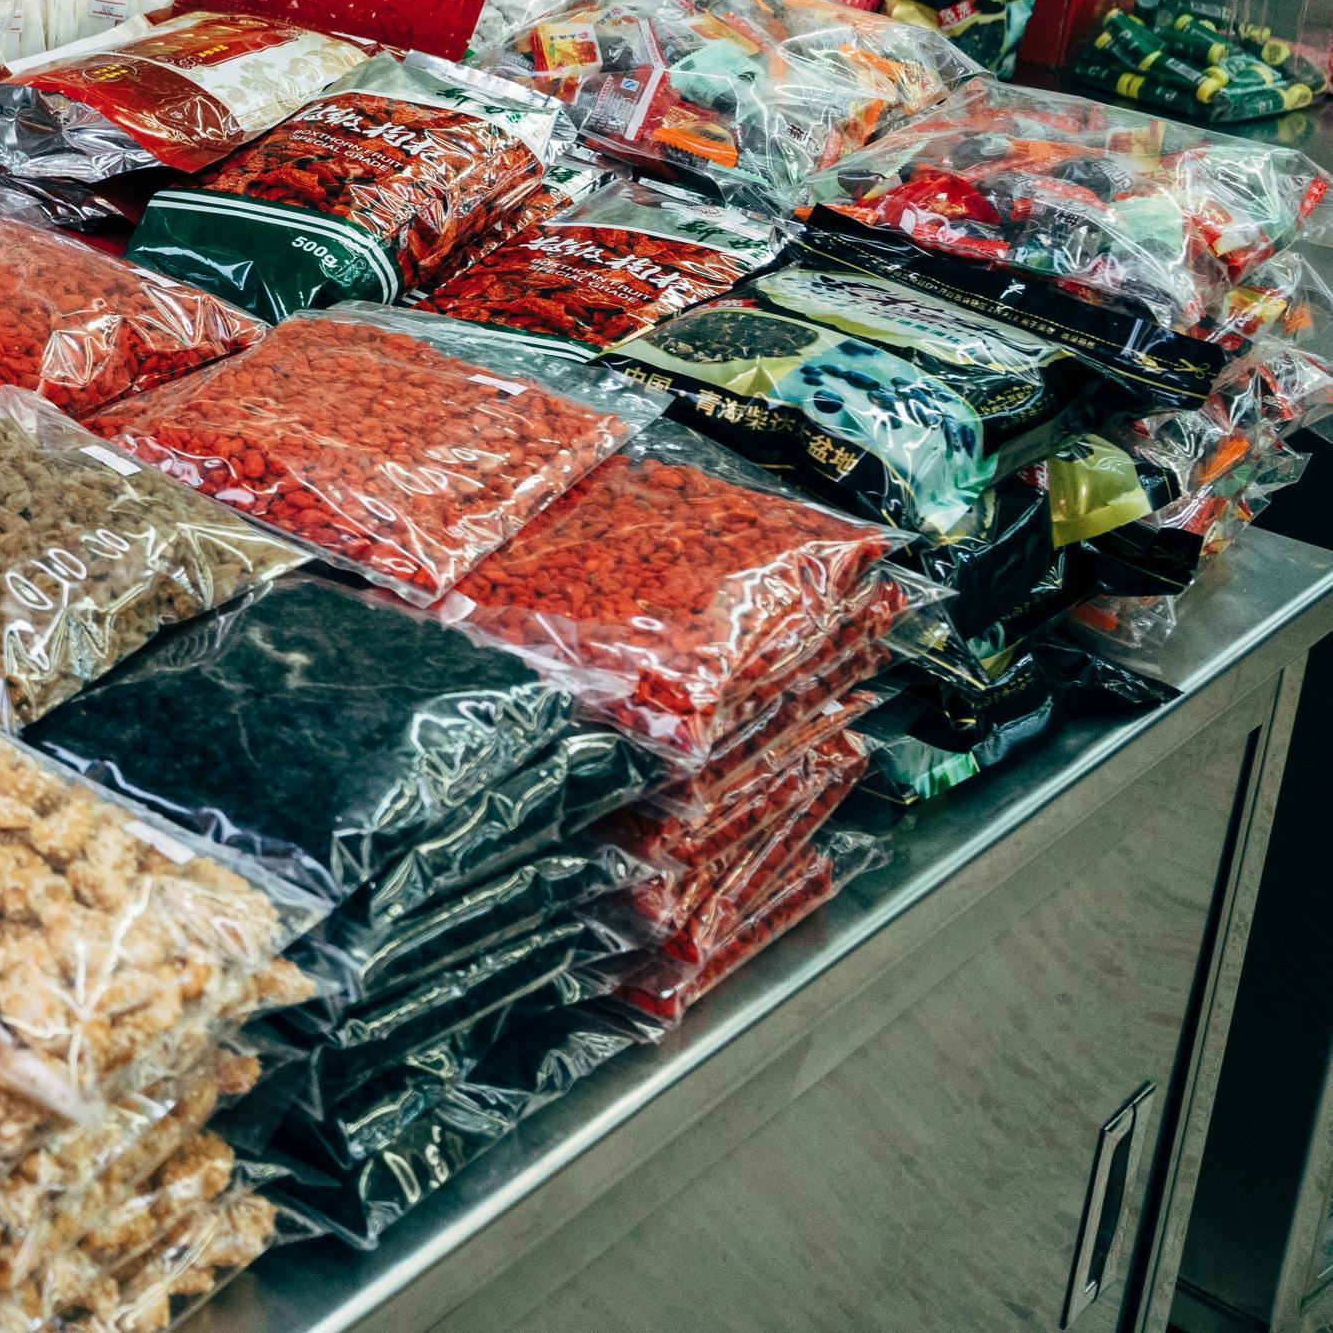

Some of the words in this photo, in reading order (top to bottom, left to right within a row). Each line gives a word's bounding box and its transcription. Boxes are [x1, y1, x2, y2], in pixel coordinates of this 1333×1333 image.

[289, 133, 340, 153] SPECIAL
[344, 150, 391, 172] GRADE
[292, 129, 362, 152] BOXTHORN
[364, 148, 405, 169] FRUIT
[291, 235, 338, 268] 500g
[529, 264, 585, 284] SPECIAL
[587, 280, 638, 304] GRADE
[530, 258, 608, 283] BOXTHORN
[610, 279, 653, 302] FRUIT
